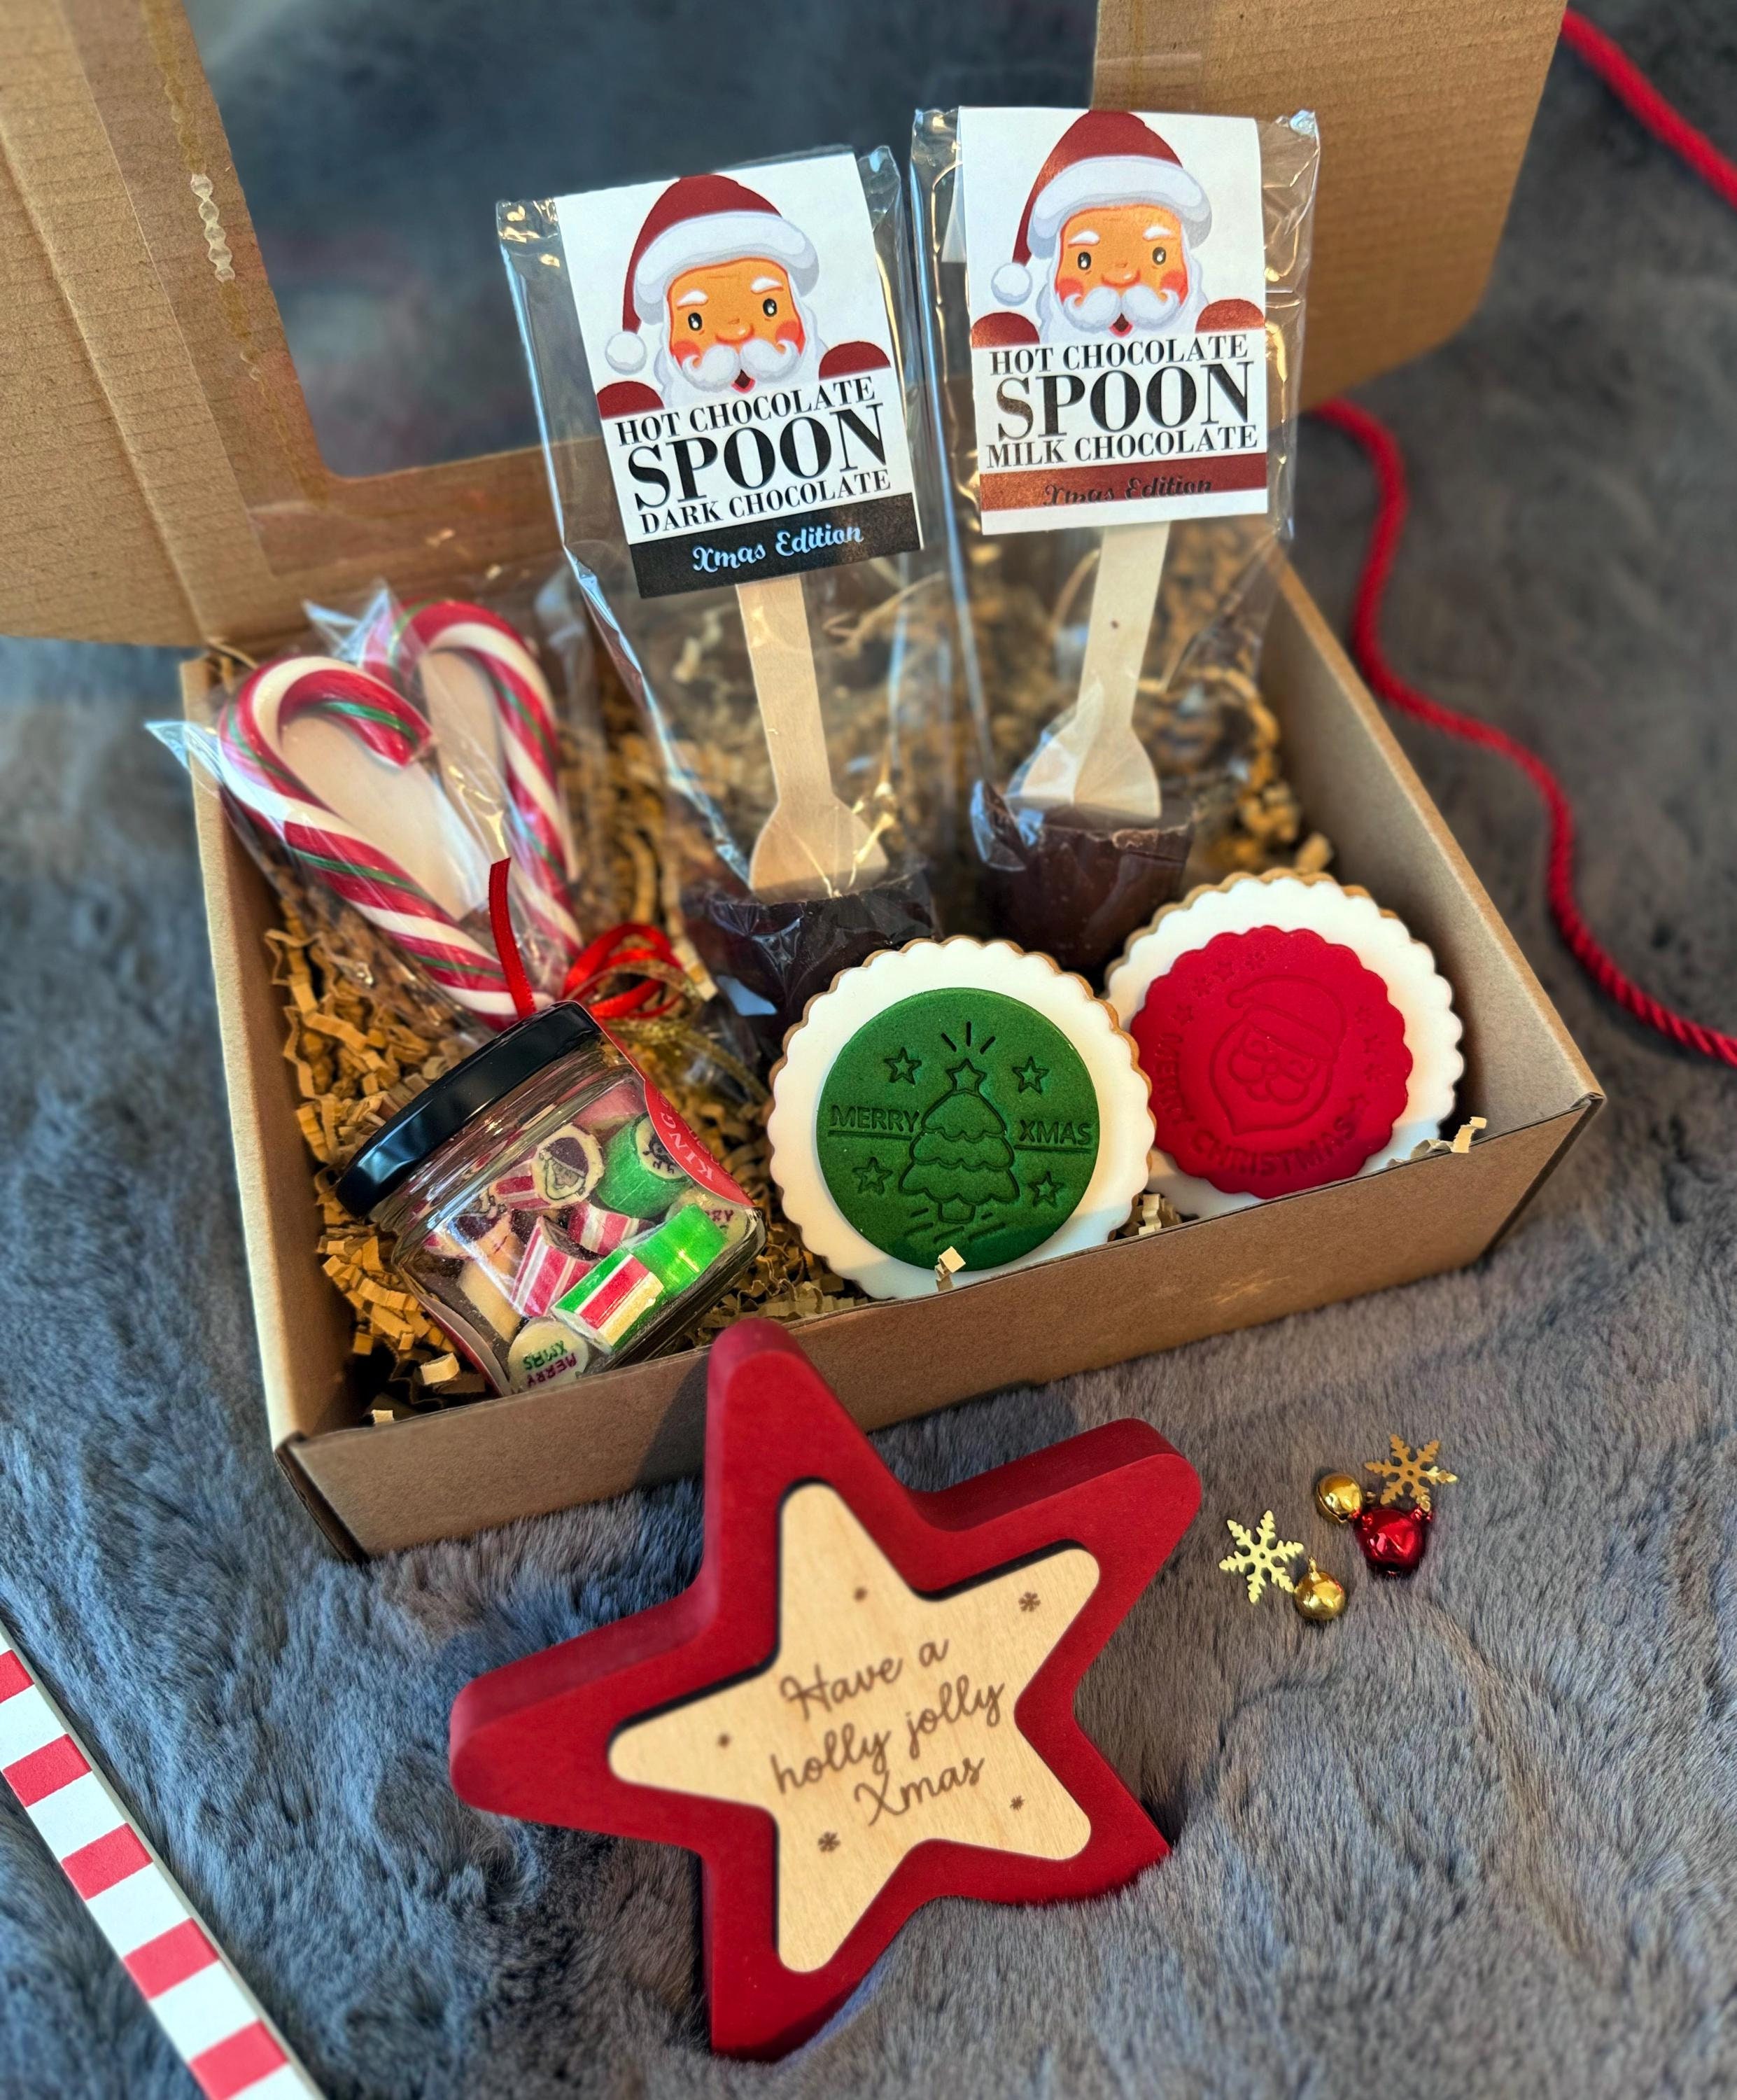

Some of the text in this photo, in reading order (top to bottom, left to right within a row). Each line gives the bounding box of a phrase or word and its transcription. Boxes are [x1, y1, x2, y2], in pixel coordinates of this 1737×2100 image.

[990, 334, 1249, 376] HOT CHOCOLATE
[614, 376, 877, 447] HOT CHOCOLATE
[996, 360, 1254, 442] SPOON
[628, 402, 889, 512] SPOON
[986, 424, 1258, 469] MILK CHOCOLATE
[639, 468, 892, 536] DARK CHOCOLATE
[1042, 475, 1212, 507] Xmas Edition
[692, 523, 864, 573] Xmas Edition
[829, 1105, 1093, 1146] MERRY XMAS
[1191, 1116, 1359, 1177] CHRISTMAS
[522, 1340, 568, 1370] XMAS
[526, 1352, 577, 1388] MERRY
[780, 1638, 950, 1721] Have a
[770, 1674, 1006, 1794] holly jolly
[853, 1757, 985, 1827] Xmas
